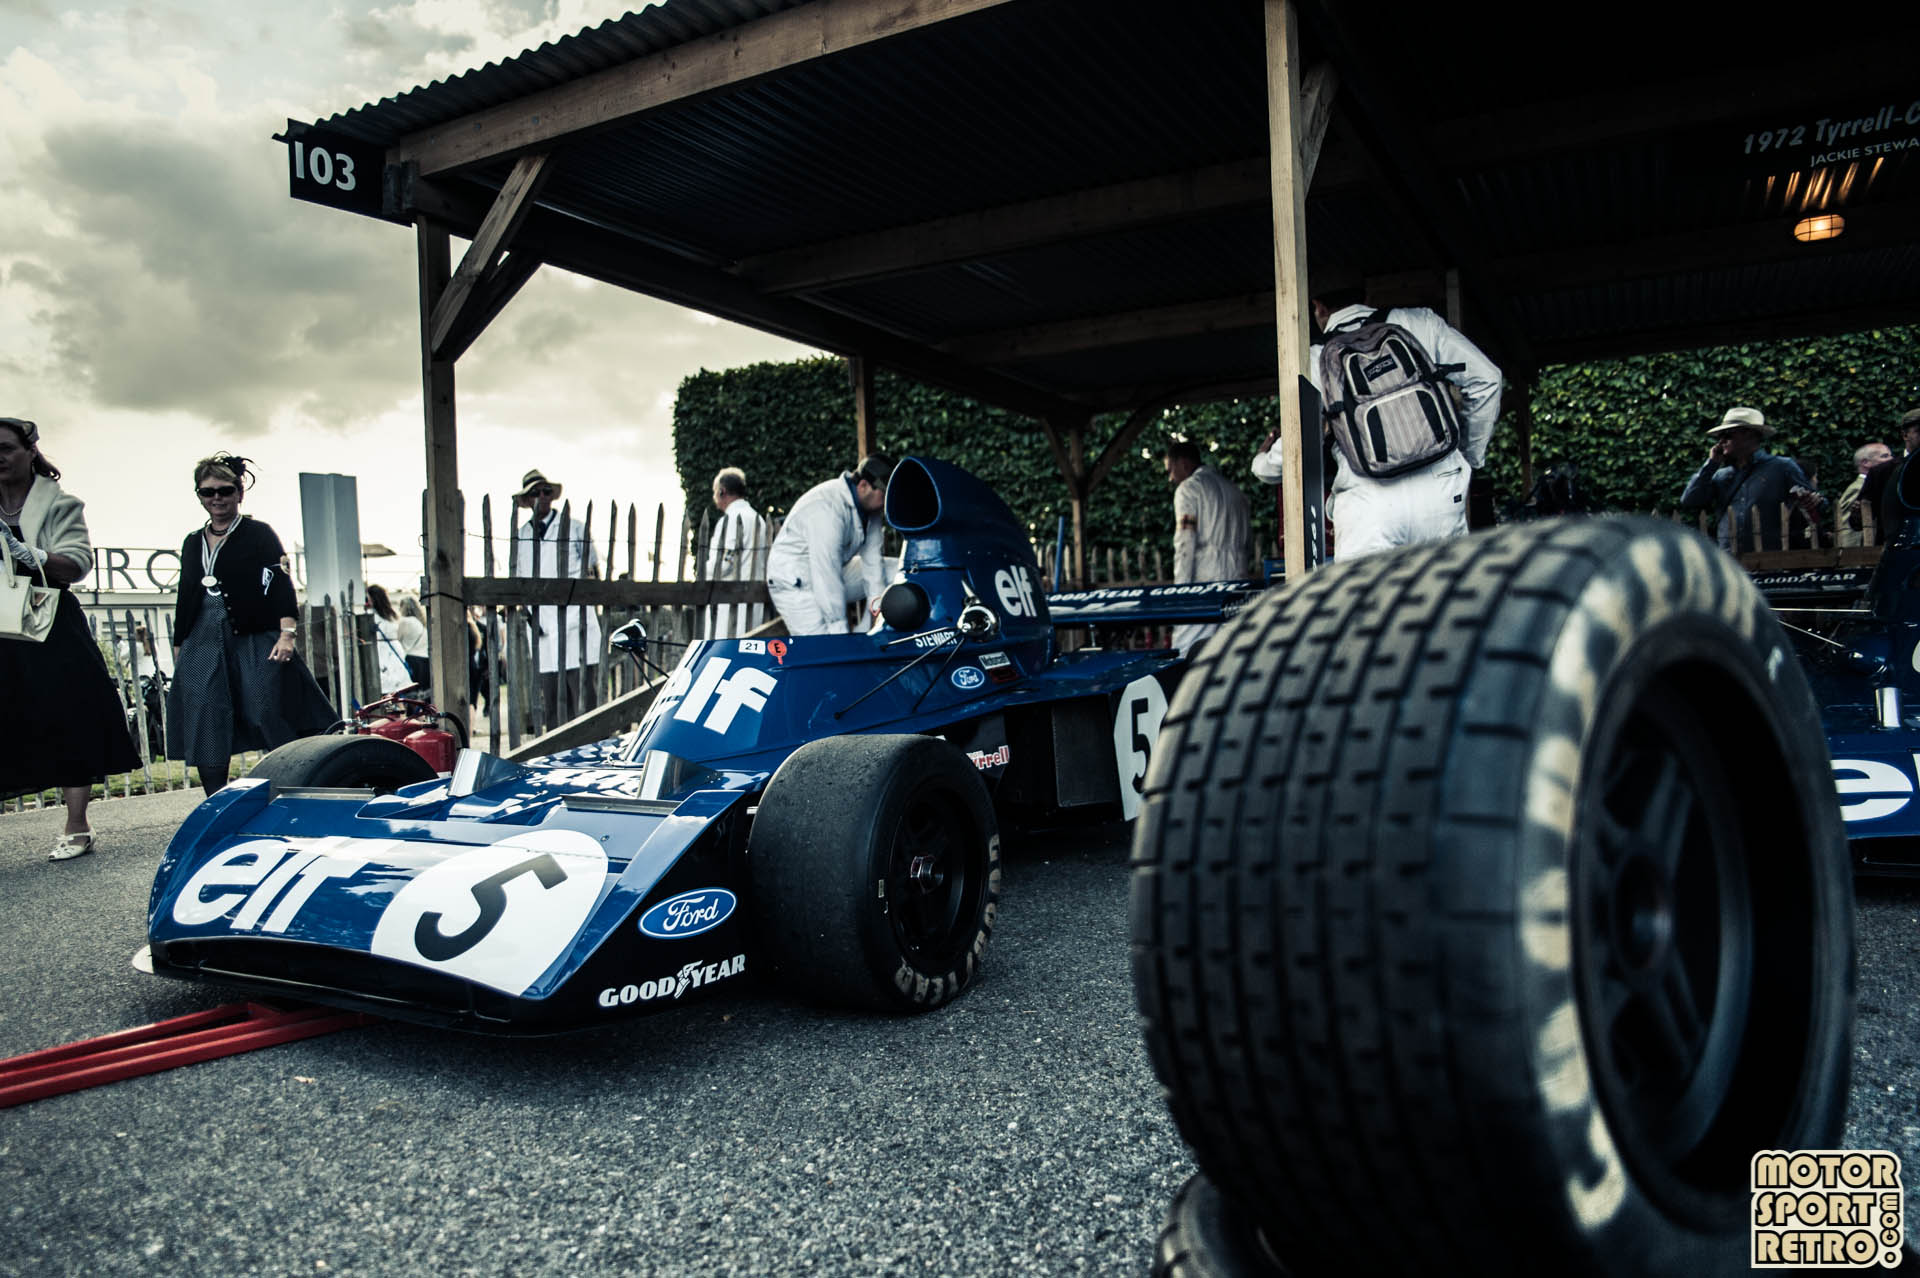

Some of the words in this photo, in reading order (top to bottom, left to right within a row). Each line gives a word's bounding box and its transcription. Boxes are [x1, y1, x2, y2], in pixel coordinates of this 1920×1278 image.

[1744, 125, 1806, 154] 1972
[1810, 148, 1861, 168] JACKIE
[294, 140, 357, 191] 103
[995, 565, 1037, 617] elf
[744, 642, 759, 651] 21
[773, 642, 782, 654] E
[1131, 697, 1151, 794] 5
[173, 837, 404, 934] elf
[414, 853, 568, 961] 5
[662, 895, 719, 931] Ford
[598, 953, 746, 1007] GOODYEAR
